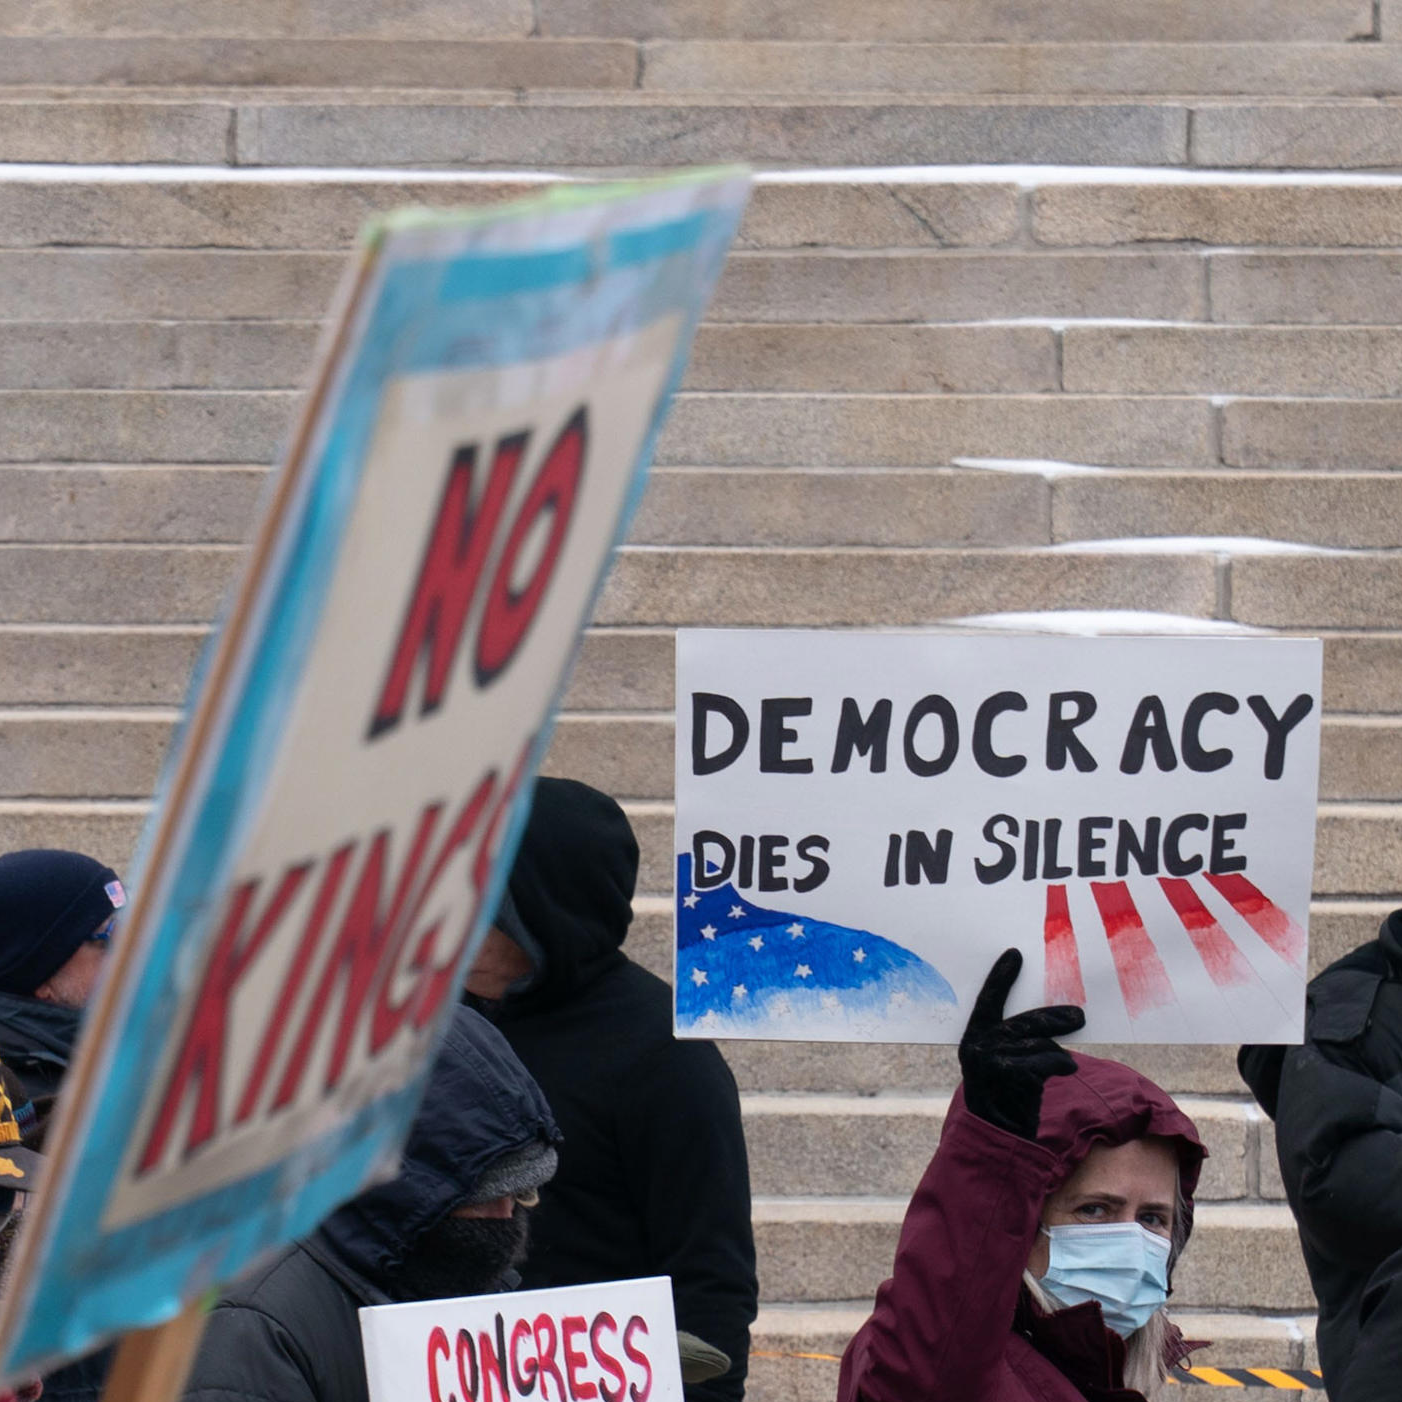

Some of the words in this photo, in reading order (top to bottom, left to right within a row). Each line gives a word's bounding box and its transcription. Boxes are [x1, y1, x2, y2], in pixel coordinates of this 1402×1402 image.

[366, 404, 591, 744] NO
[691, 690, 1314, 780] DEMOCRACY
[692, 829, 831, 894] DIES
[883, 828, 954, 888] IN
[973, 812, 1249, 886] SILENCE
